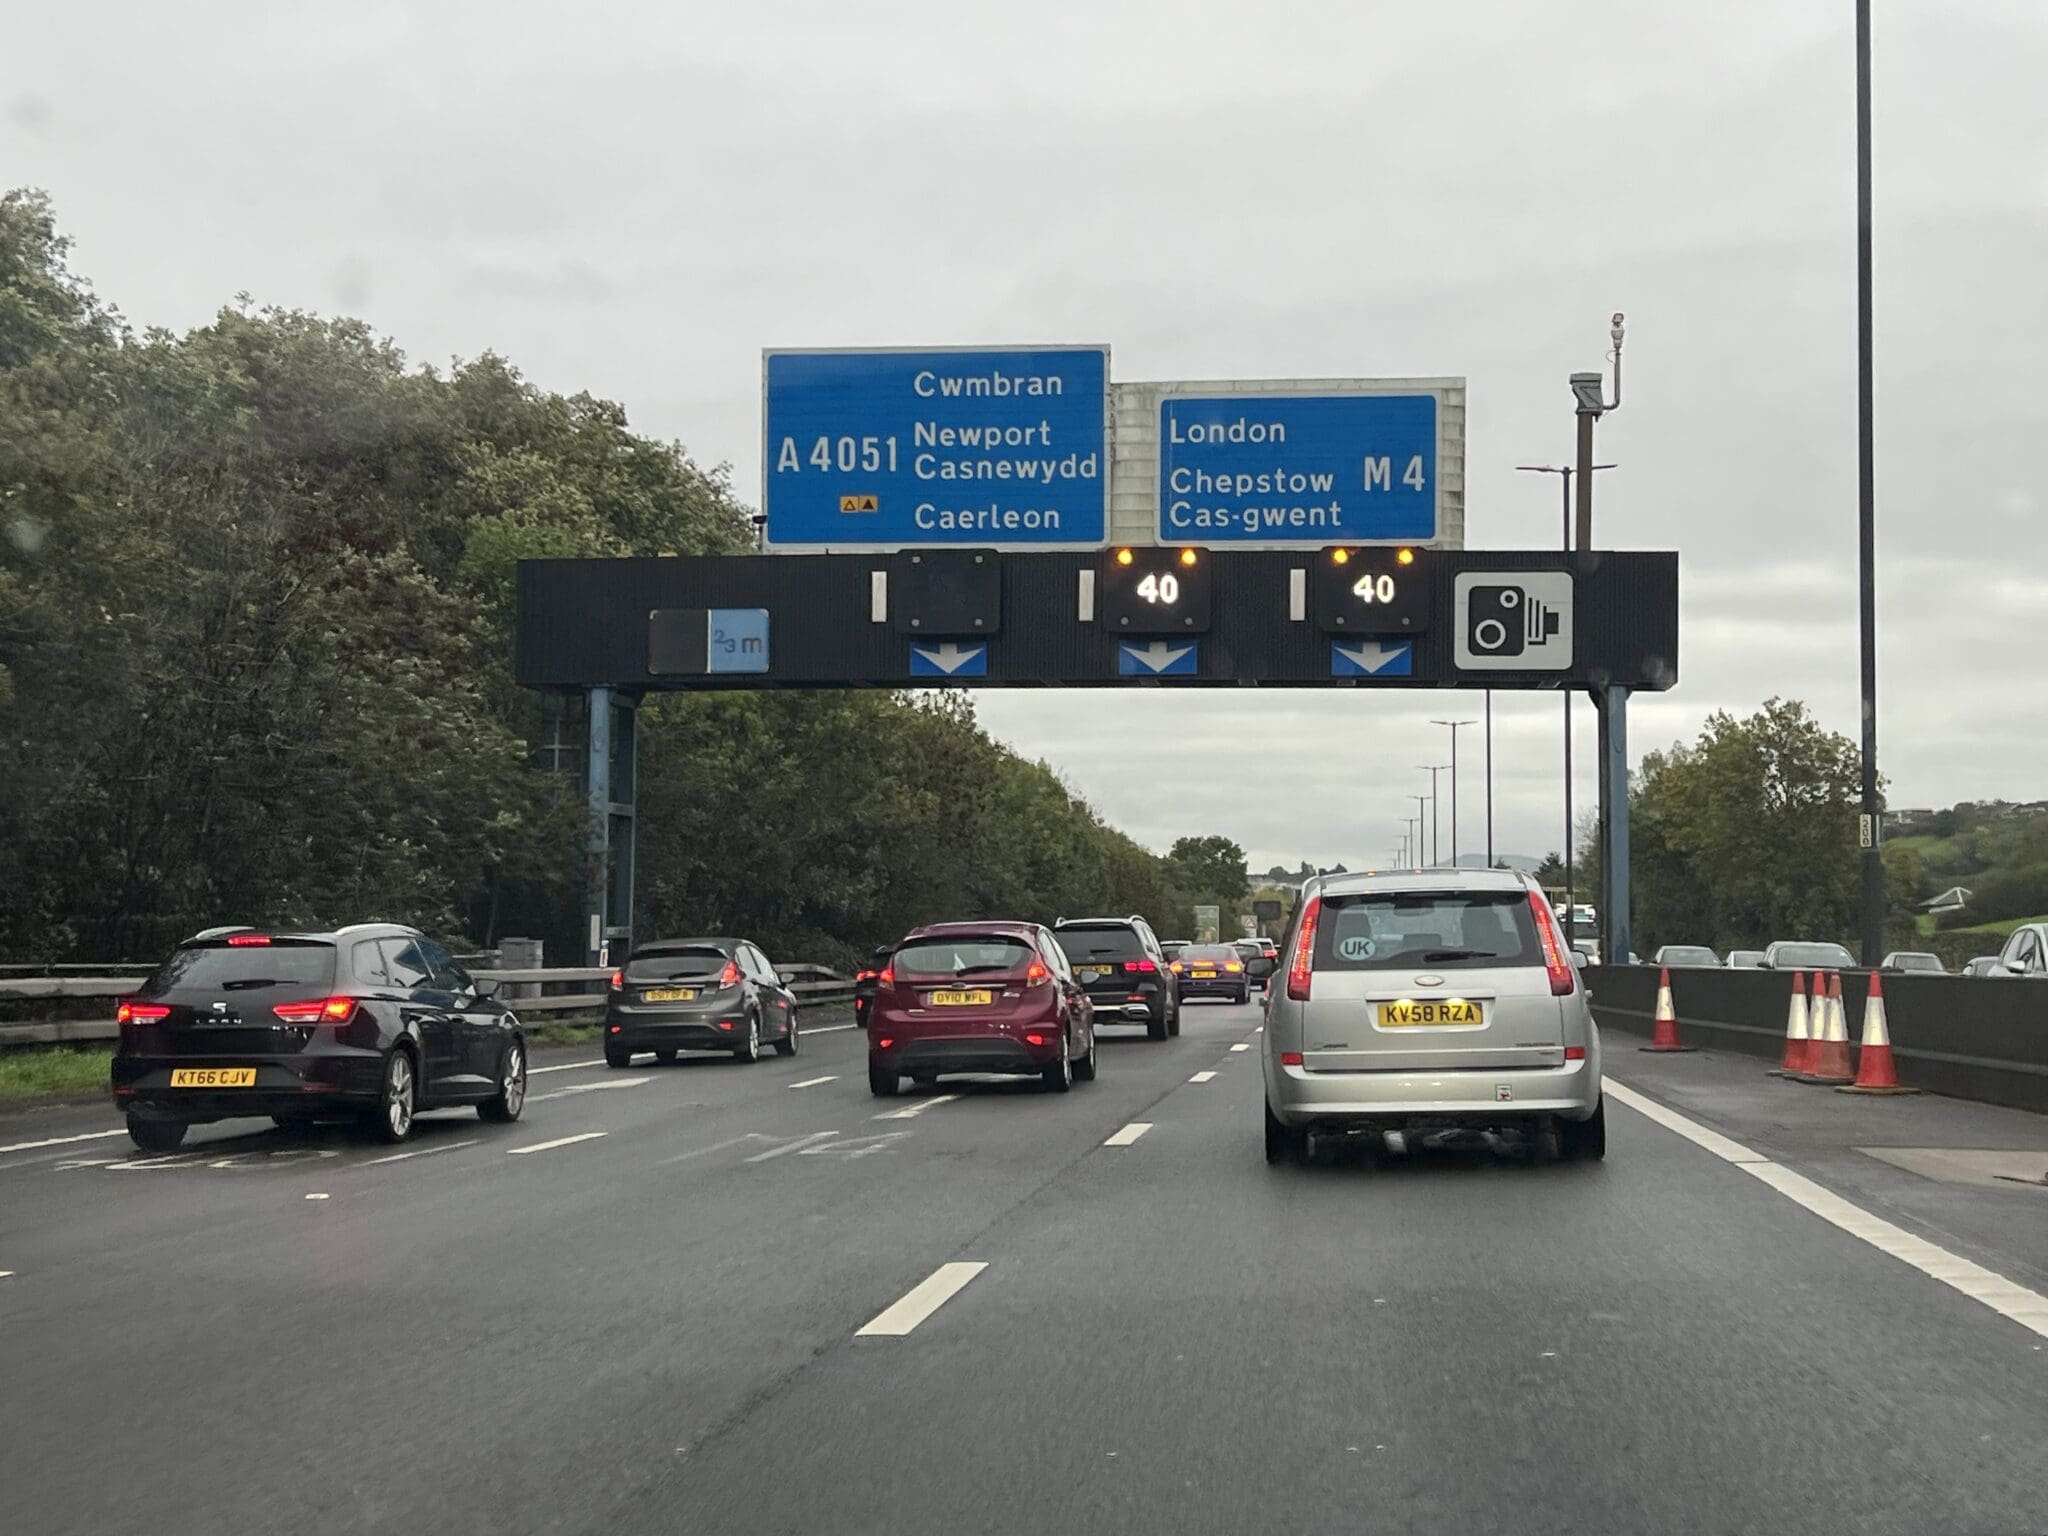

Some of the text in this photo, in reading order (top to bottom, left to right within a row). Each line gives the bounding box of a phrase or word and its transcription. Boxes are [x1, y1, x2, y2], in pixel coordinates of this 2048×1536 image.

[913, 371, 1062, 397] Cwmbran
[914, 420, 1051, 450] Newport
[1170, 418, 1286, 443] London
[914, 453, 1097, 483] Casnewydd
[1170, 468, 1334, 497] Chepstow
[914, 503, 1060, 529] Caerleon
[1169, 501, 1342, 532] Cas-gwent
[1137, 574, 1179, 603] 40
[1353, 574, 1395, 603] 40
[1344, 941, 1370, 955] UK
[1386, 1004, 1475, 1023] KV58 RZA
[177, 1071, 250, 1084] KT66 CJV
